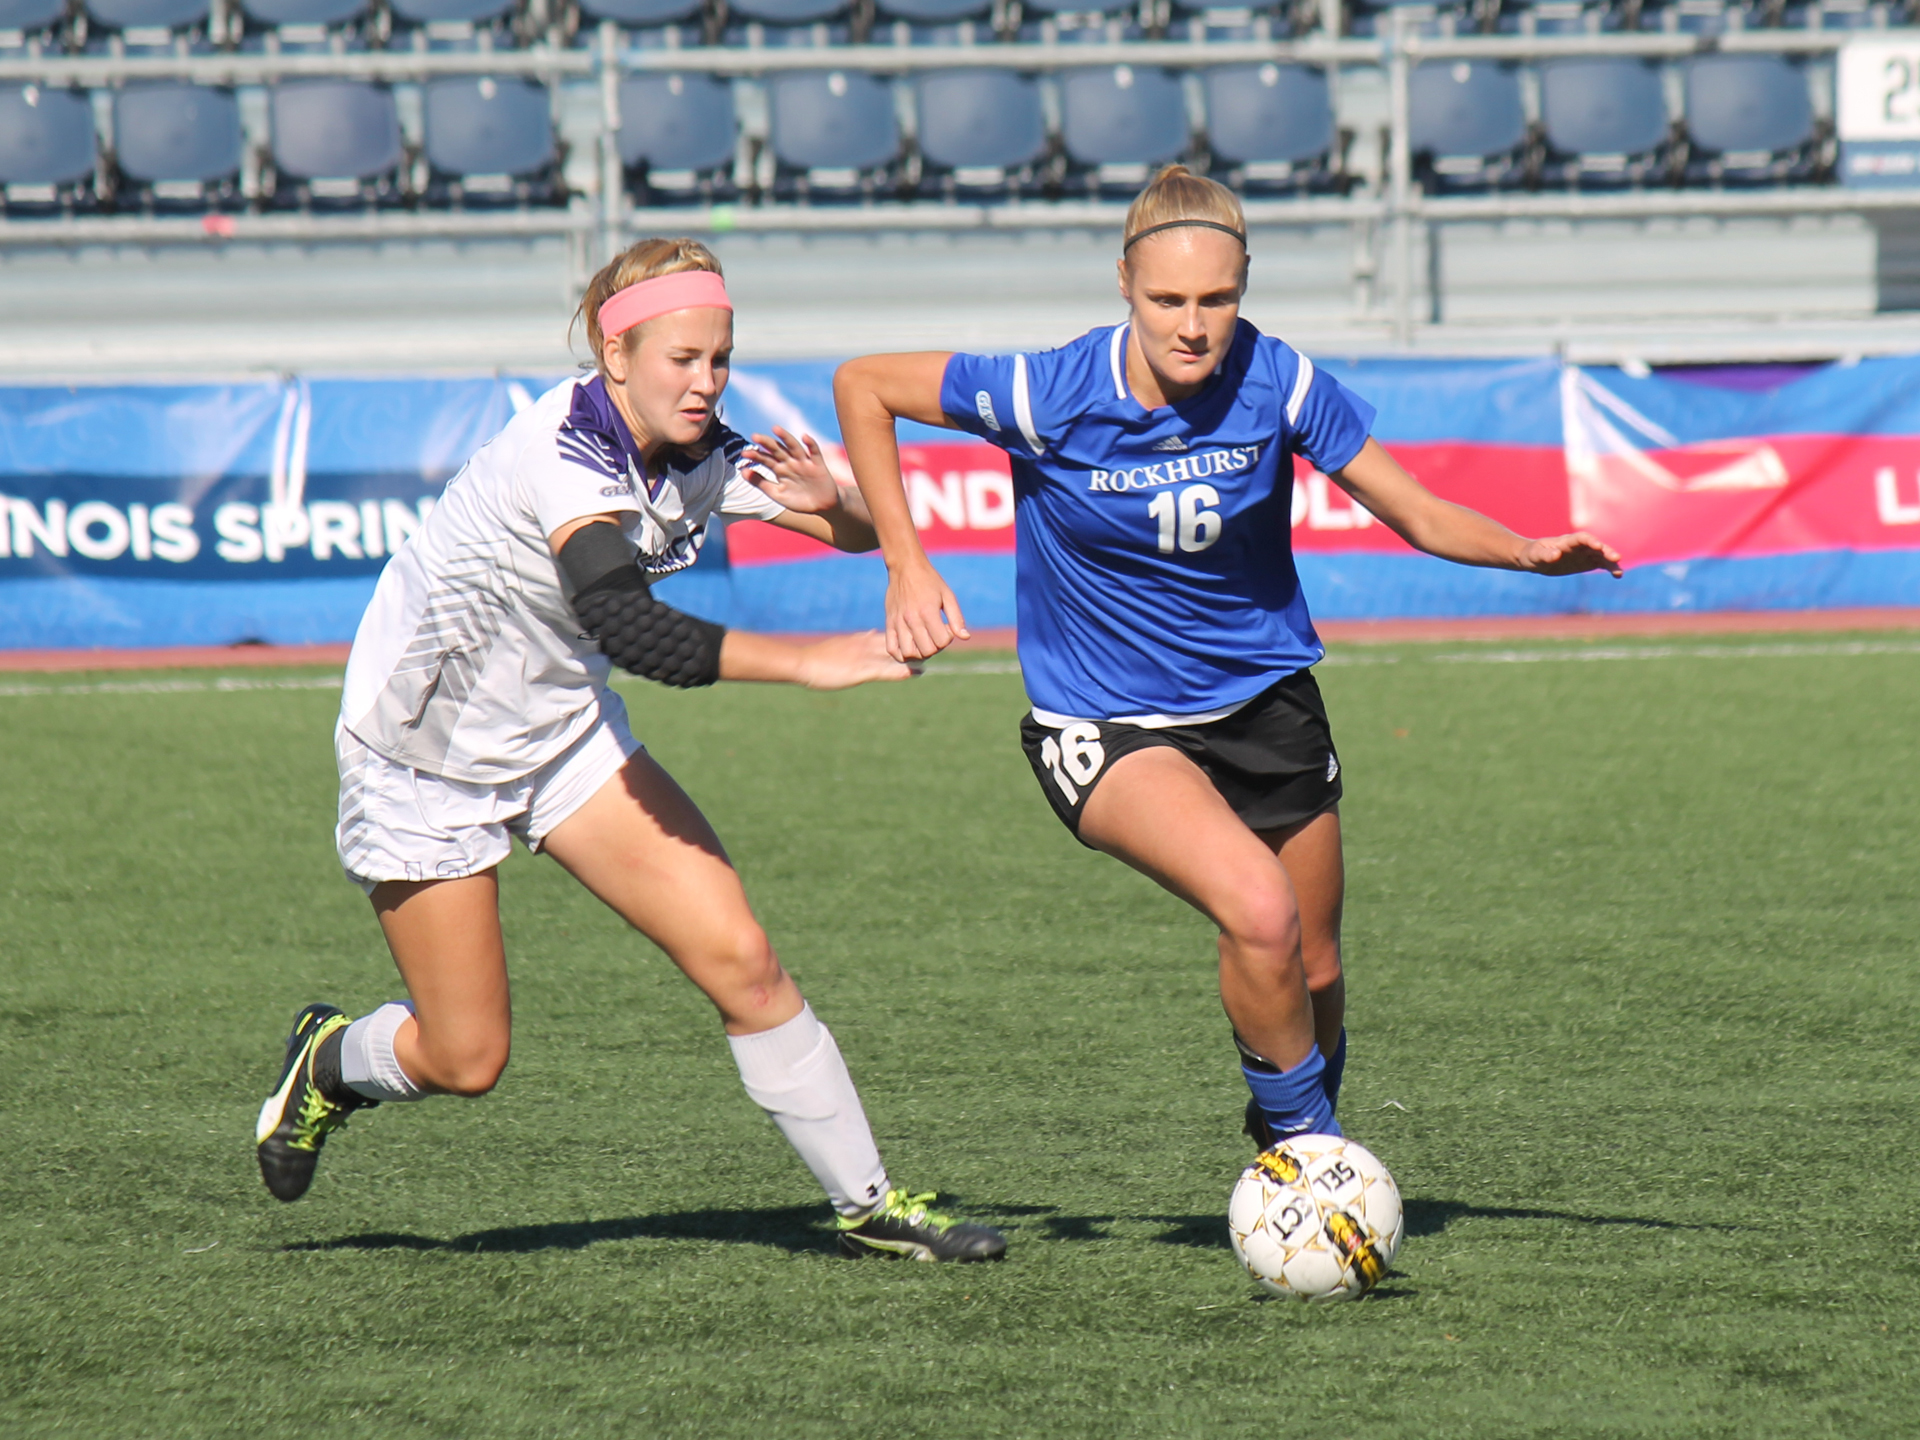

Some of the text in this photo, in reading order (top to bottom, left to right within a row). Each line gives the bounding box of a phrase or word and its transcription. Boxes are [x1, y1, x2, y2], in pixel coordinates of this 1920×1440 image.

[1088, 443, 1264, 493] ROCKHURST
[1147, 483, 1222, 554] 16
[1040, 721, 1105, 806] 16
